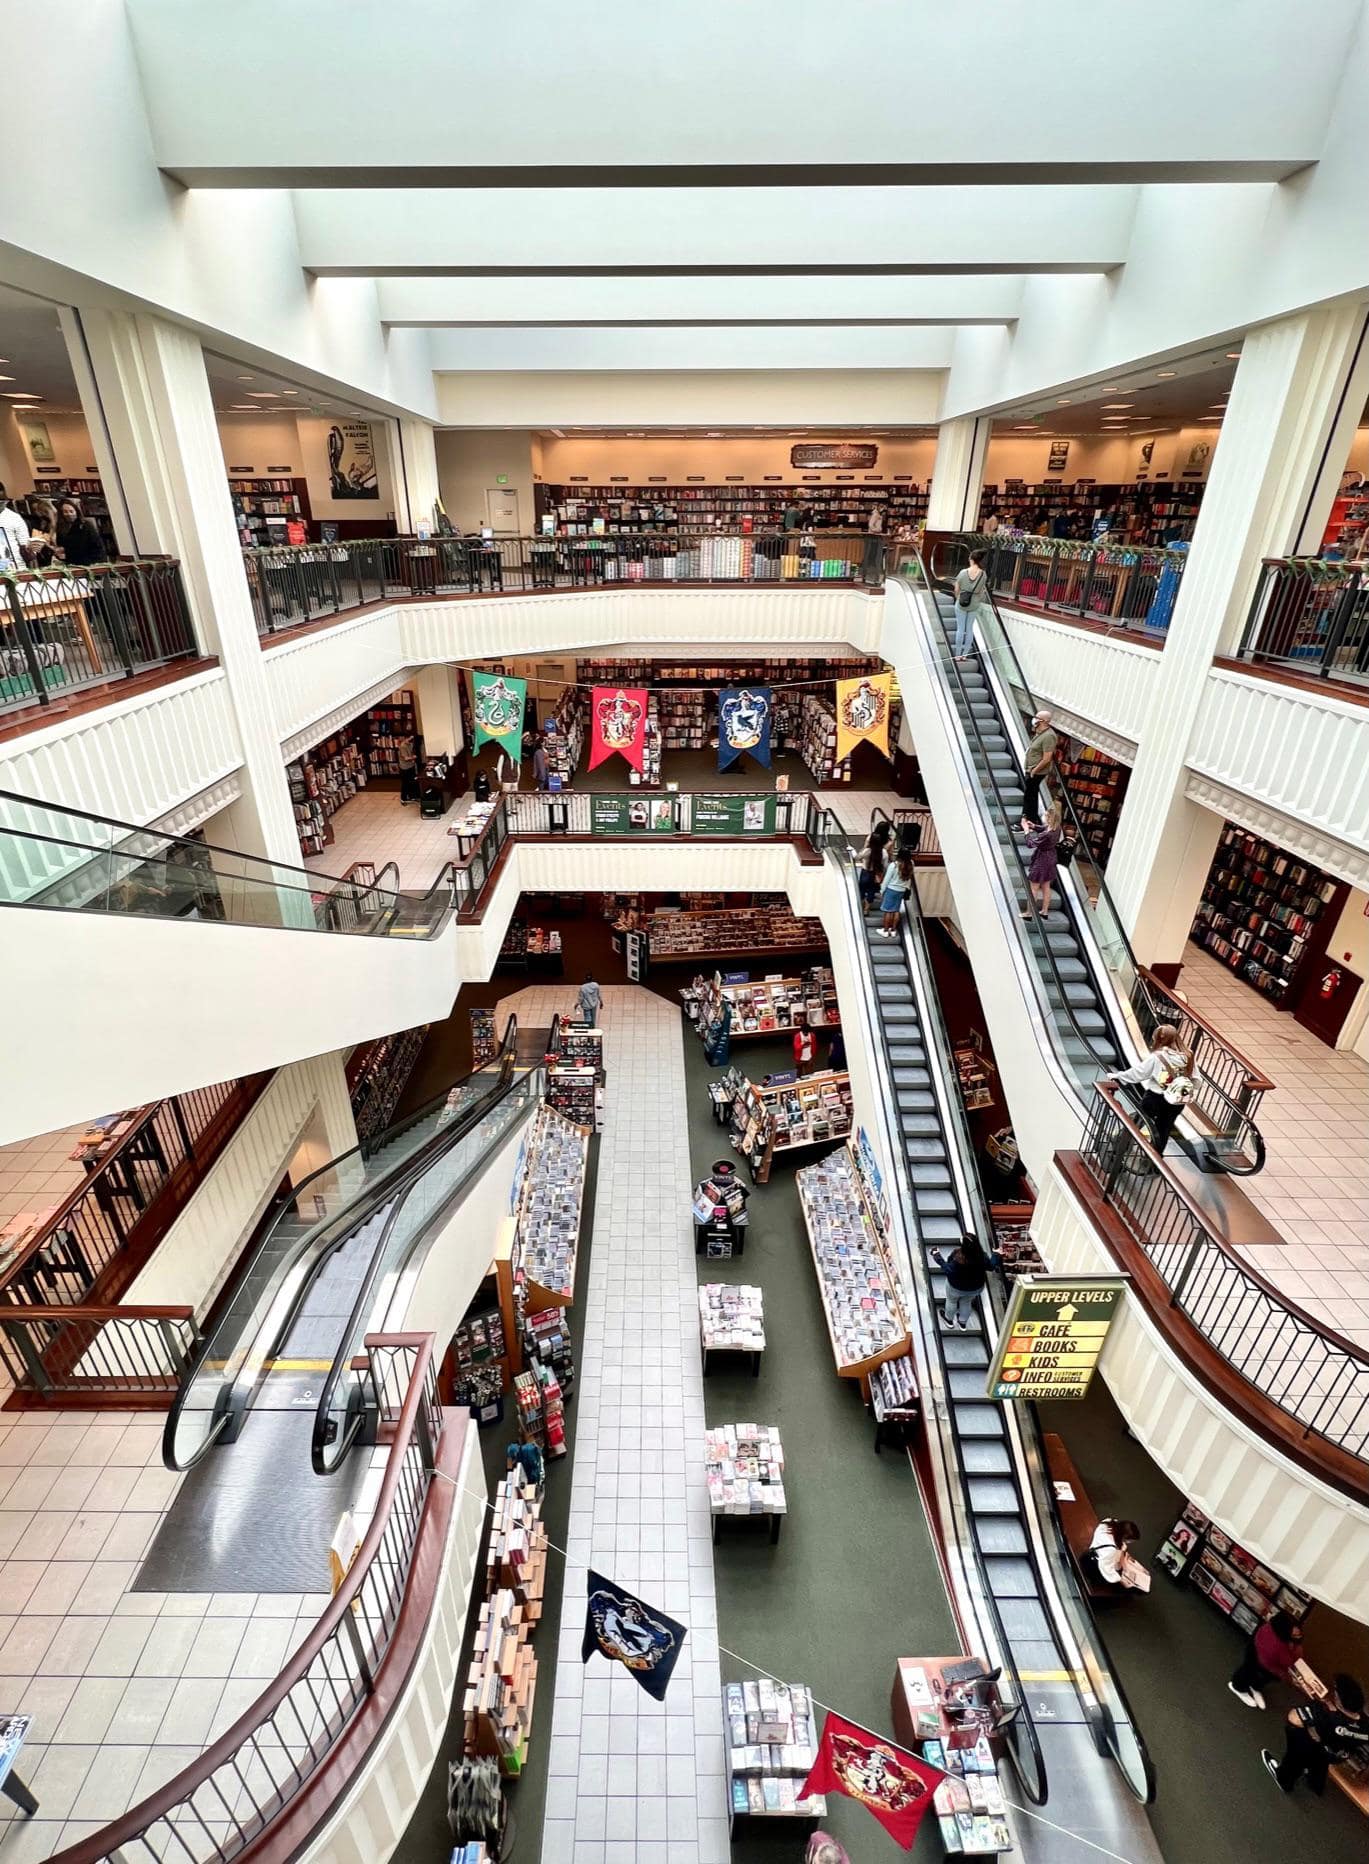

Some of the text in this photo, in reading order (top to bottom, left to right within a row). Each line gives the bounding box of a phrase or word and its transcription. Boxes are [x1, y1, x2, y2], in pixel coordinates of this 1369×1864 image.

[796, 449, 841, 459] CUSTOMER
[774, 1073, 792, 1081] VINYL
[1030, 1291, 1114, 1303] UPPER LEVELS
[1034, 1341, 1077, 1353] BOOKS
[1029, 1356, 1060, 1368] KIDS
[1024, 1371, 1053, 1383] INFO
[1019, 1387, 1082, 1397] RESTROOMS
